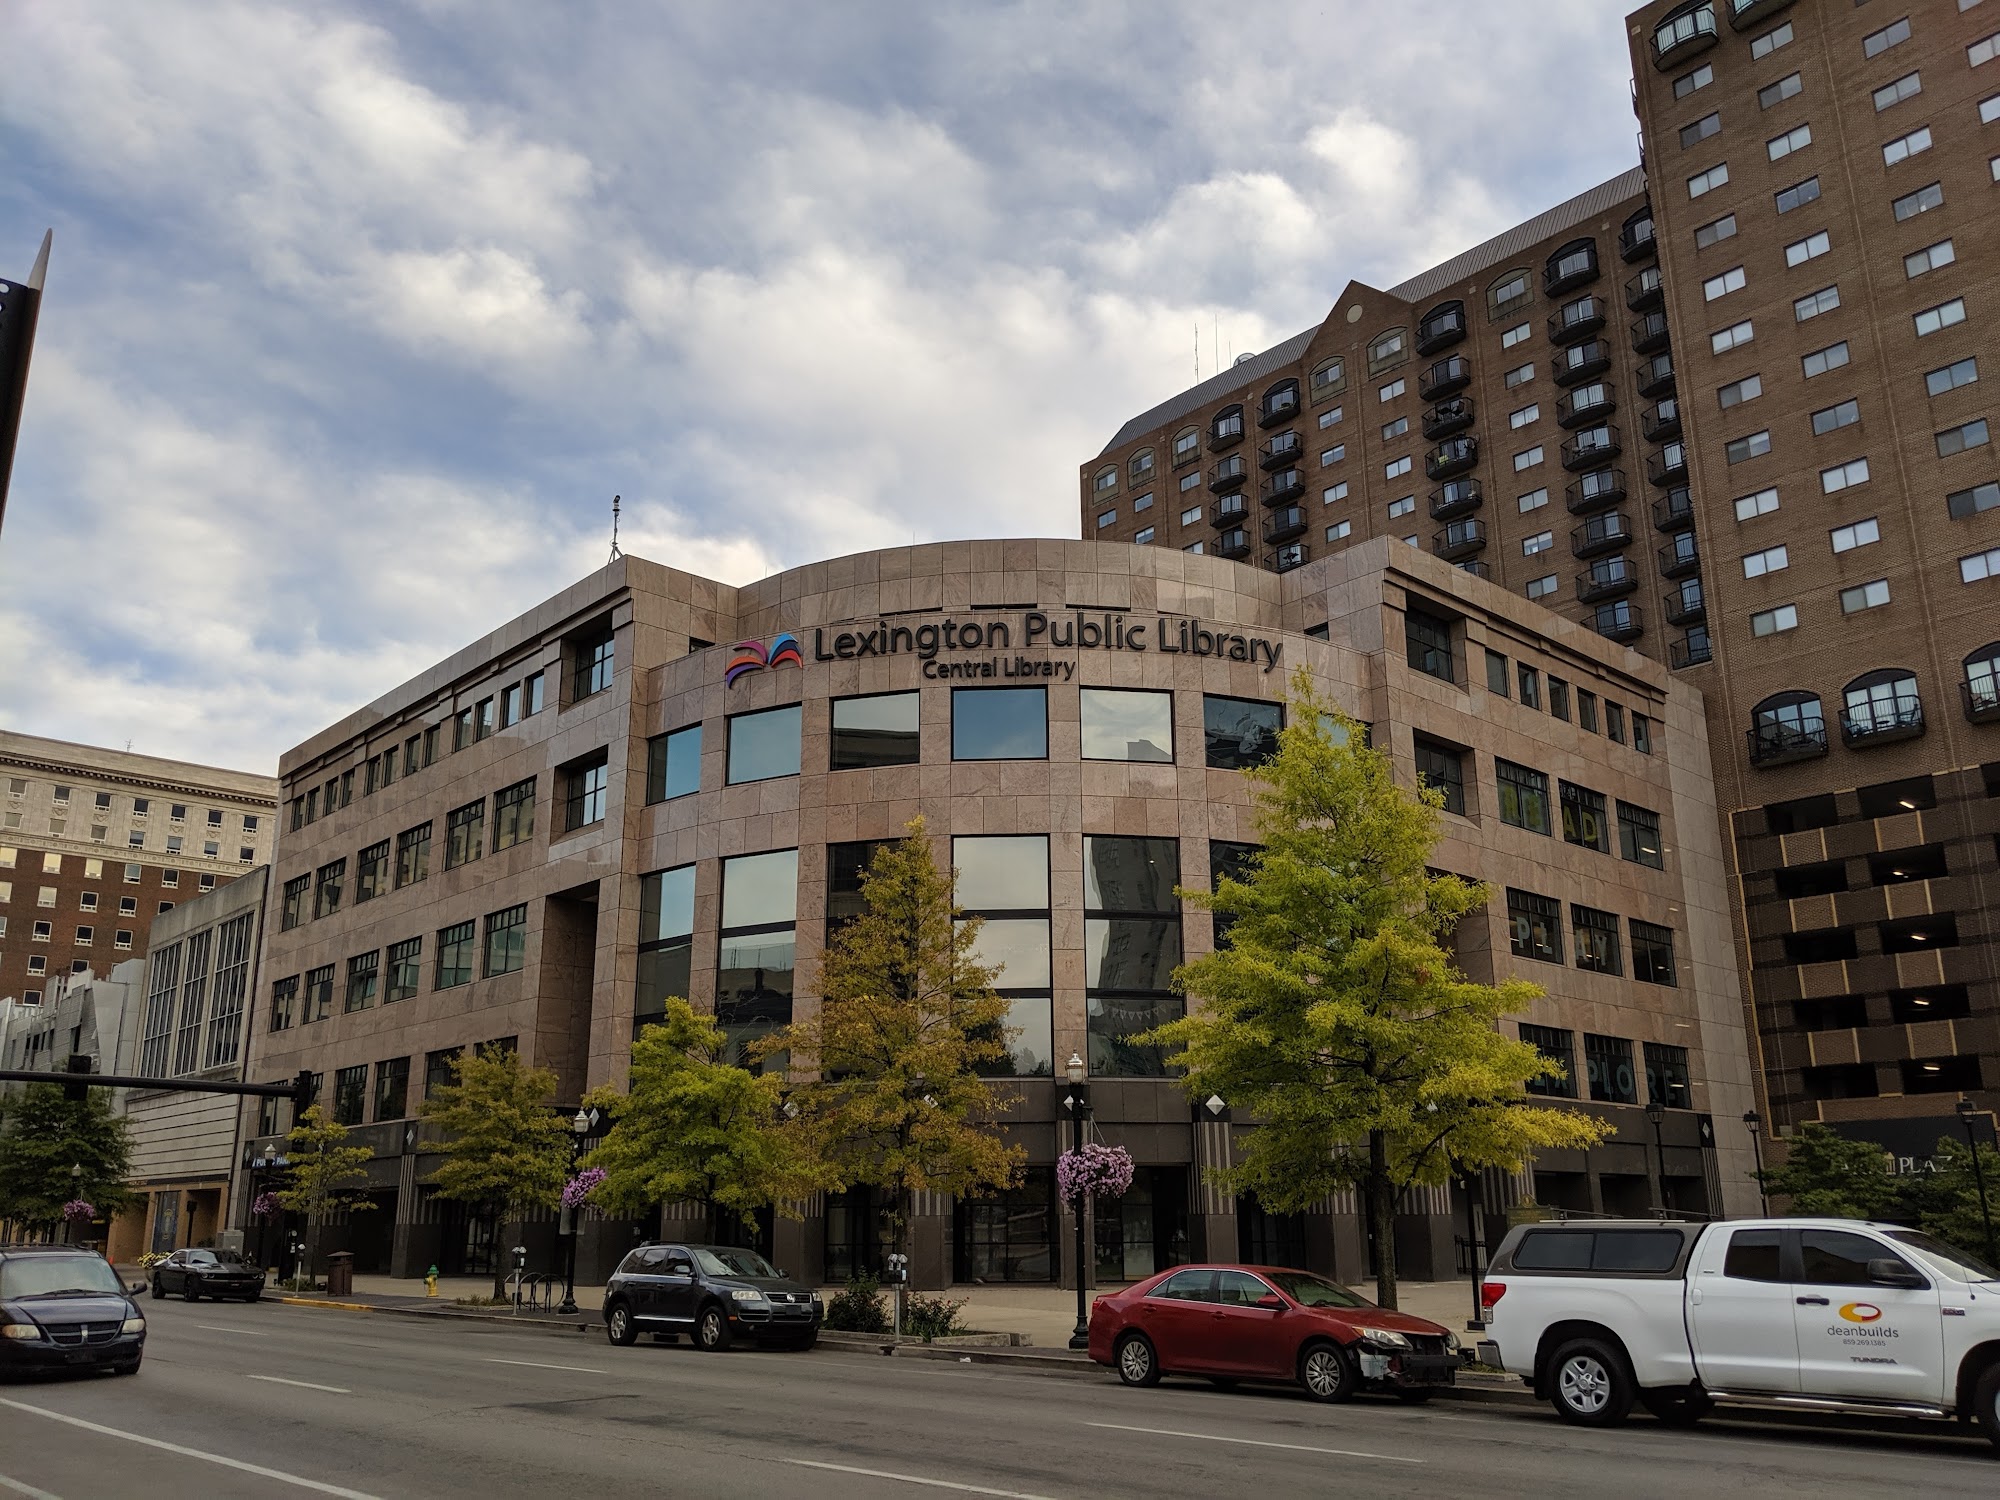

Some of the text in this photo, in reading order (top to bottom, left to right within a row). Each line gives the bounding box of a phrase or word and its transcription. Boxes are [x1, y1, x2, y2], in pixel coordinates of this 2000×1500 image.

[815, 611, 1283, 673] Lexington Public Library
[922, 656, 1076, 681] Central Library
[1516, 916, 1607, 967] PLAY
[1899, 1156, 1969, 1174] PLAZ
[1827, 1325, 1899, 1338] deanbuilds
[1850, 1356, 1898, 1365] TUNDRA
